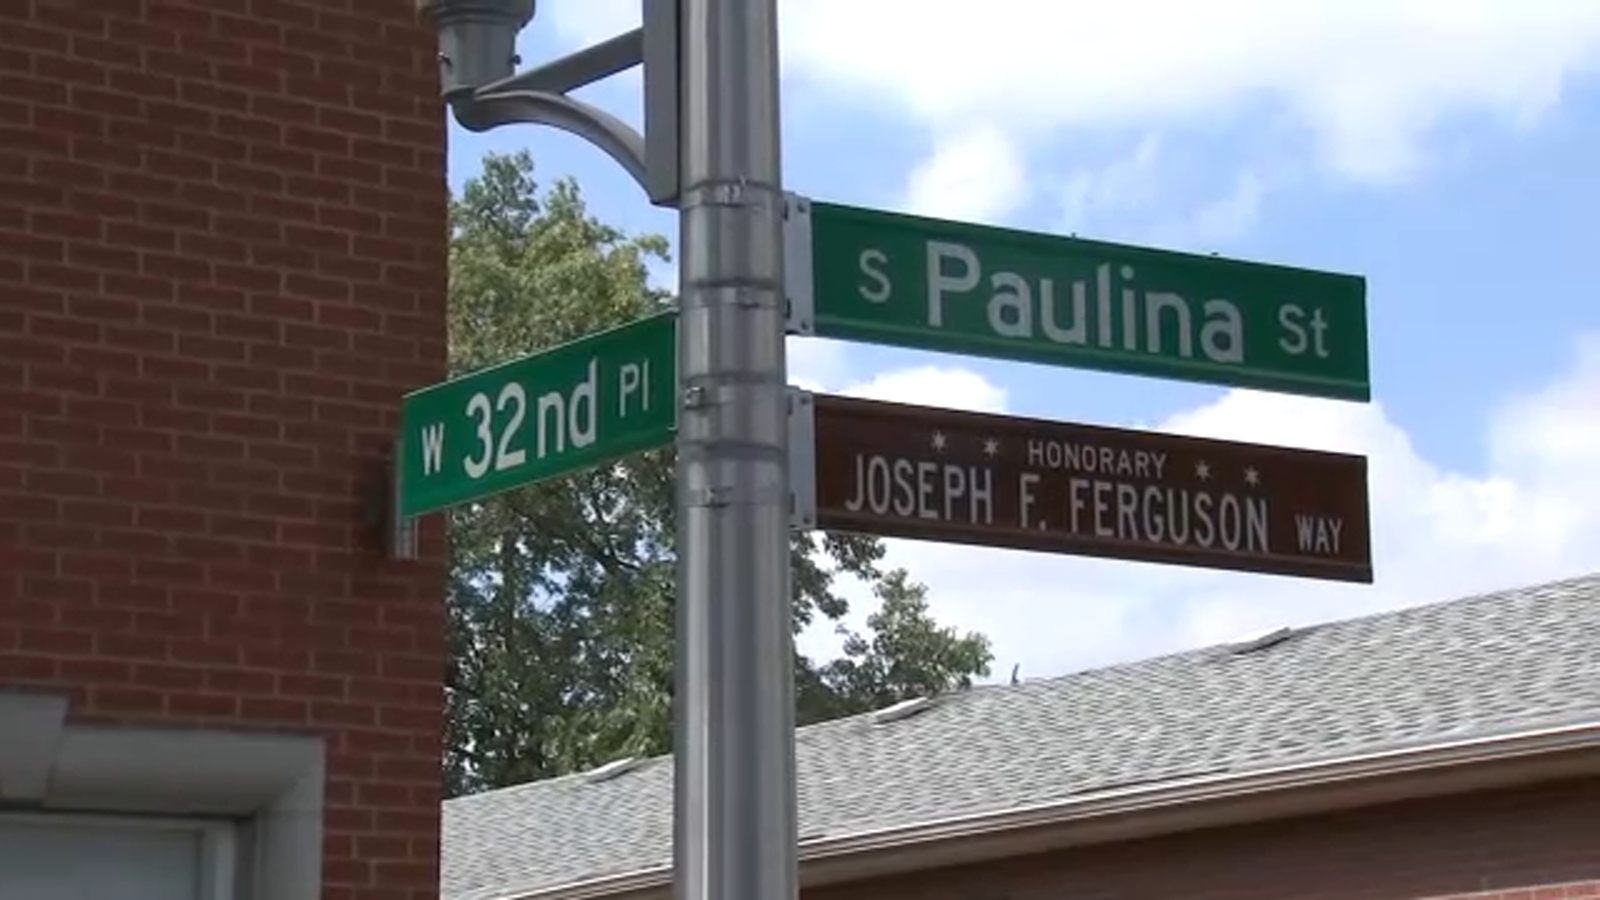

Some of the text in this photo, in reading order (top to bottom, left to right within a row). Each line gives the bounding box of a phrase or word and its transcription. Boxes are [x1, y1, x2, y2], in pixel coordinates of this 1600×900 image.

[858, 240, 1330, 364] S Paulina St
[421, 421, 445, 477] W
[463, 357, 598, 479] 32nd
[1028, 438, 1168, 480] HONORARY
[845, 454, 1345, 555] JOSEPH F. FERGUSON WAY
